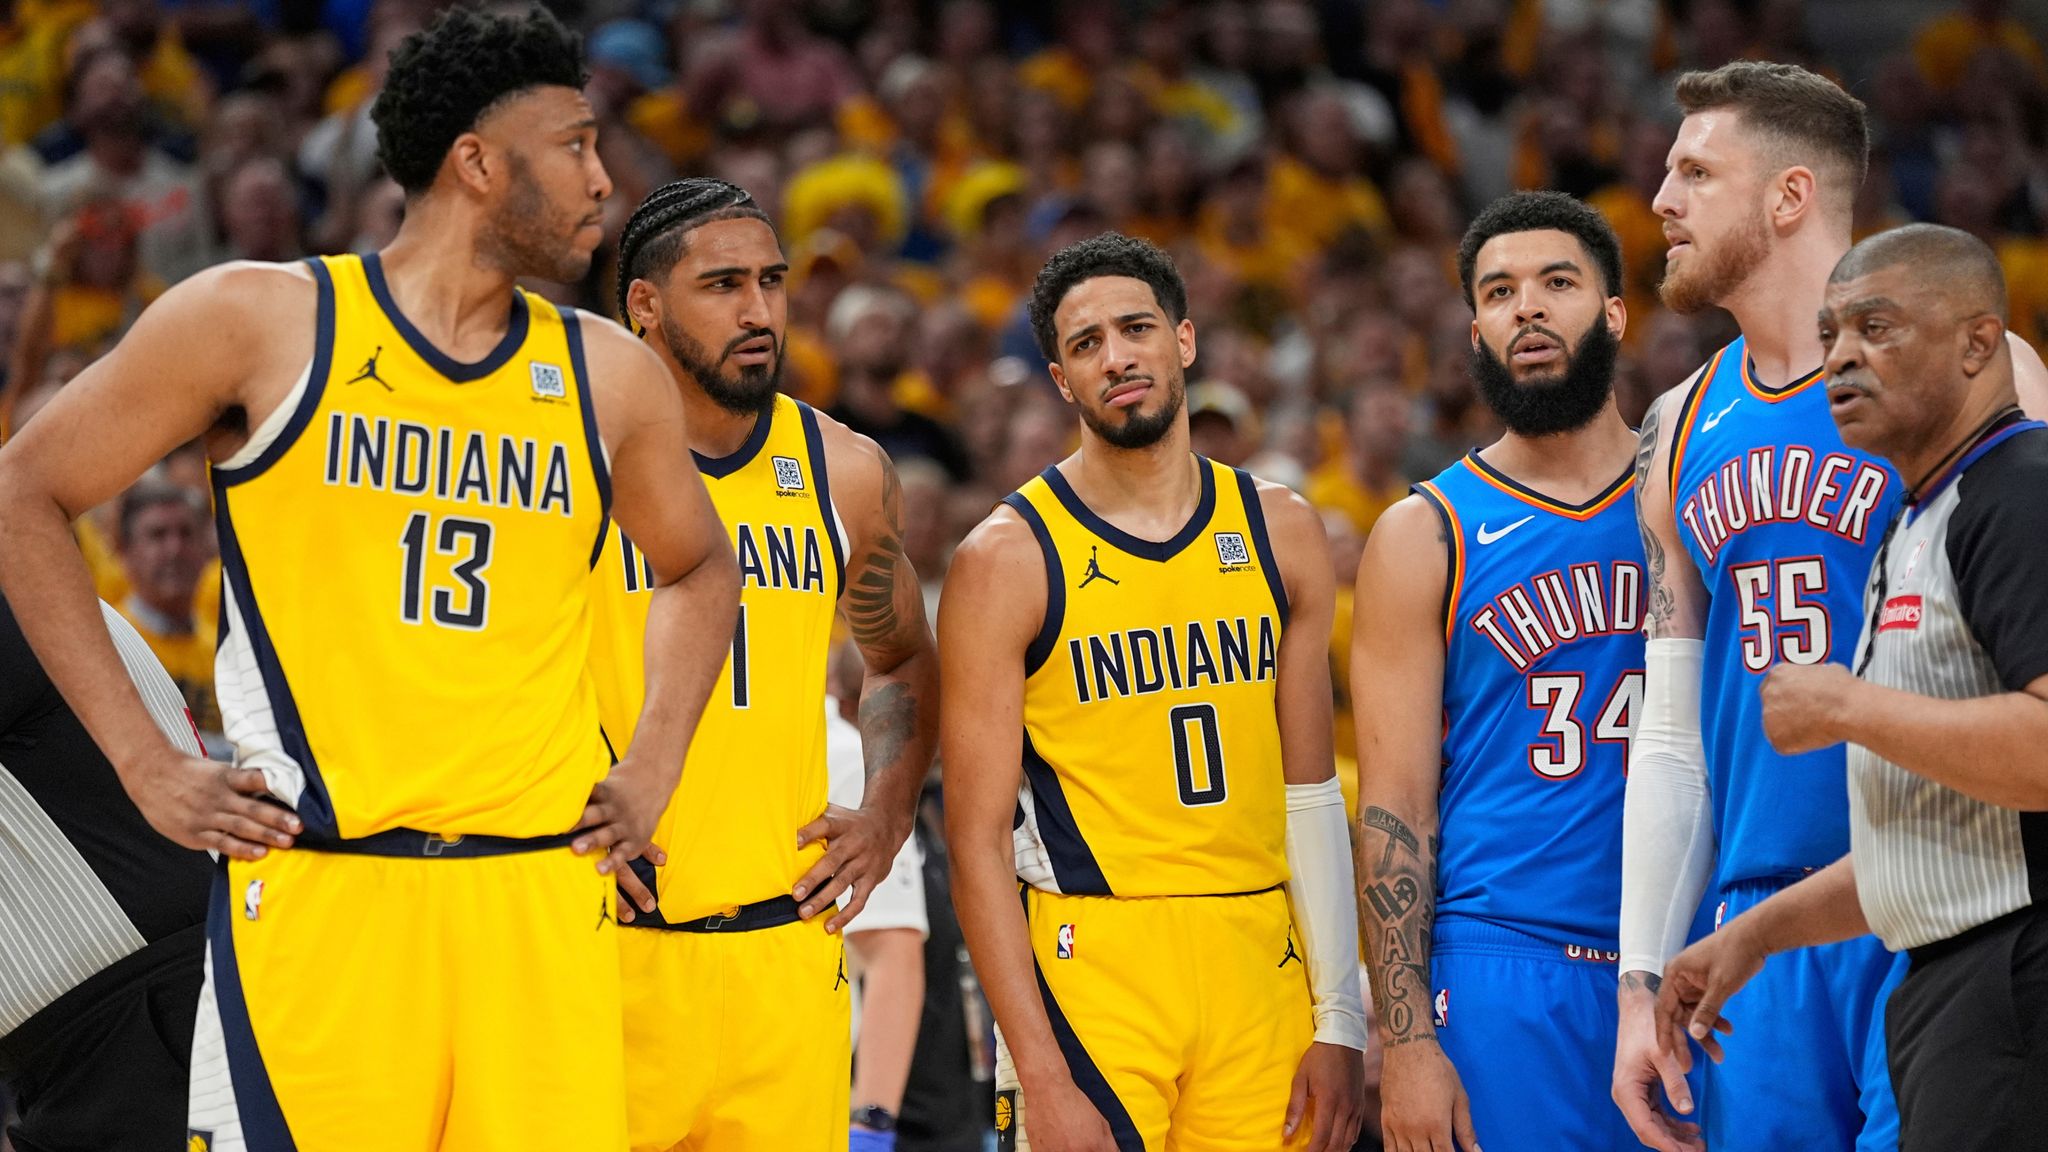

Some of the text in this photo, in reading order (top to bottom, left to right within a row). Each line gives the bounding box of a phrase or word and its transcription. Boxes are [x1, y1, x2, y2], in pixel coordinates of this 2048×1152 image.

[324, 411, 573, 518] INDIANA
[1682, 445, 1889, 567] THUNDER
[398, 511, 495, 632] 13
[619, 524, 824, 595] IANA
[1218, 565, 1256, 574] spokenote
[731, 602, 749, 709] 1
[1068, 615, 1278, 704] INDIANA
[1470, 560, 1648, 674] THUND
[1729, 555, 1827, 674] 55
[1168, 702, 1228, 807] 0
[1527, 669, 1647, 781] 34
[1376, 811, 1410, 839] JAMES
